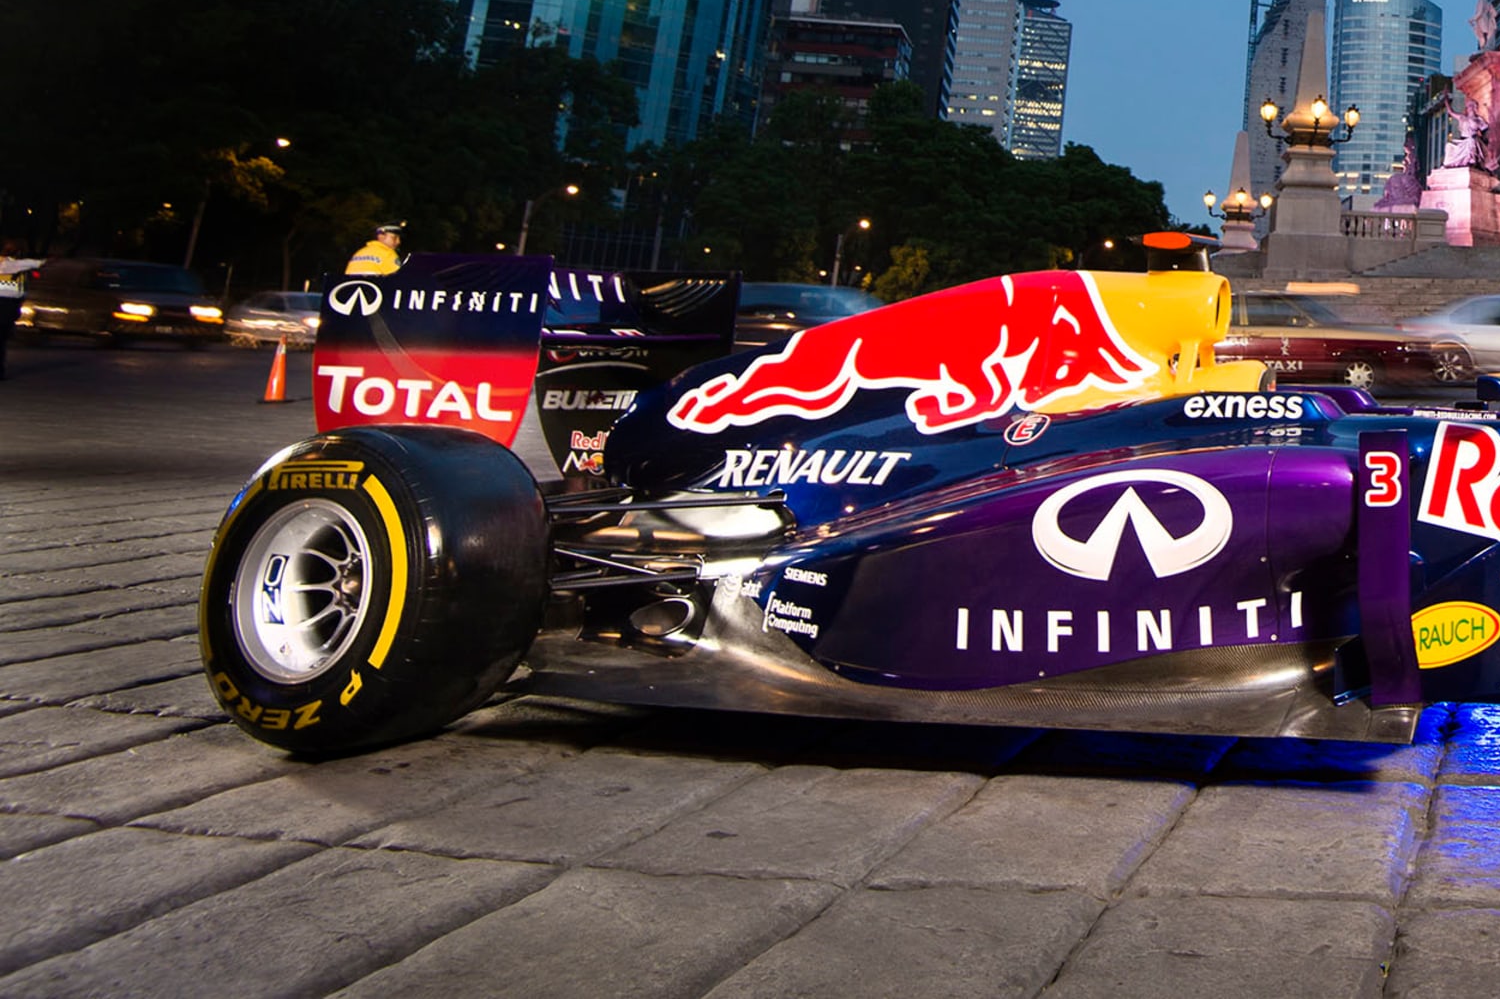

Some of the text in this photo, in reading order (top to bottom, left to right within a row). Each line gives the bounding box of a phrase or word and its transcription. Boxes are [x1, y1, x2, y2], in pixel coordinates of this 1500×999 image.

[393, 290, 538, 313] INFINITI
[1264, 360, 1303, 370] TAXI
[317, 365, 513, 422] TOTAL
[1184, 395, 1304, 419] exness
[268, 460, 365, 490] PIRELLI
[718, 450, 912, 487] RENAULT
[1365, 451, 1402, 507] 3
[784, 567, 828, 587] SIEMENS
[770, 599, 812, 619] Platform
[956, 592, 1304, 652] INFINITI
[768, 614, 819, 639] Computing
[1420, 616, 1485, 652] RAUCH
[213, 669, 363, 730] P ZERO
